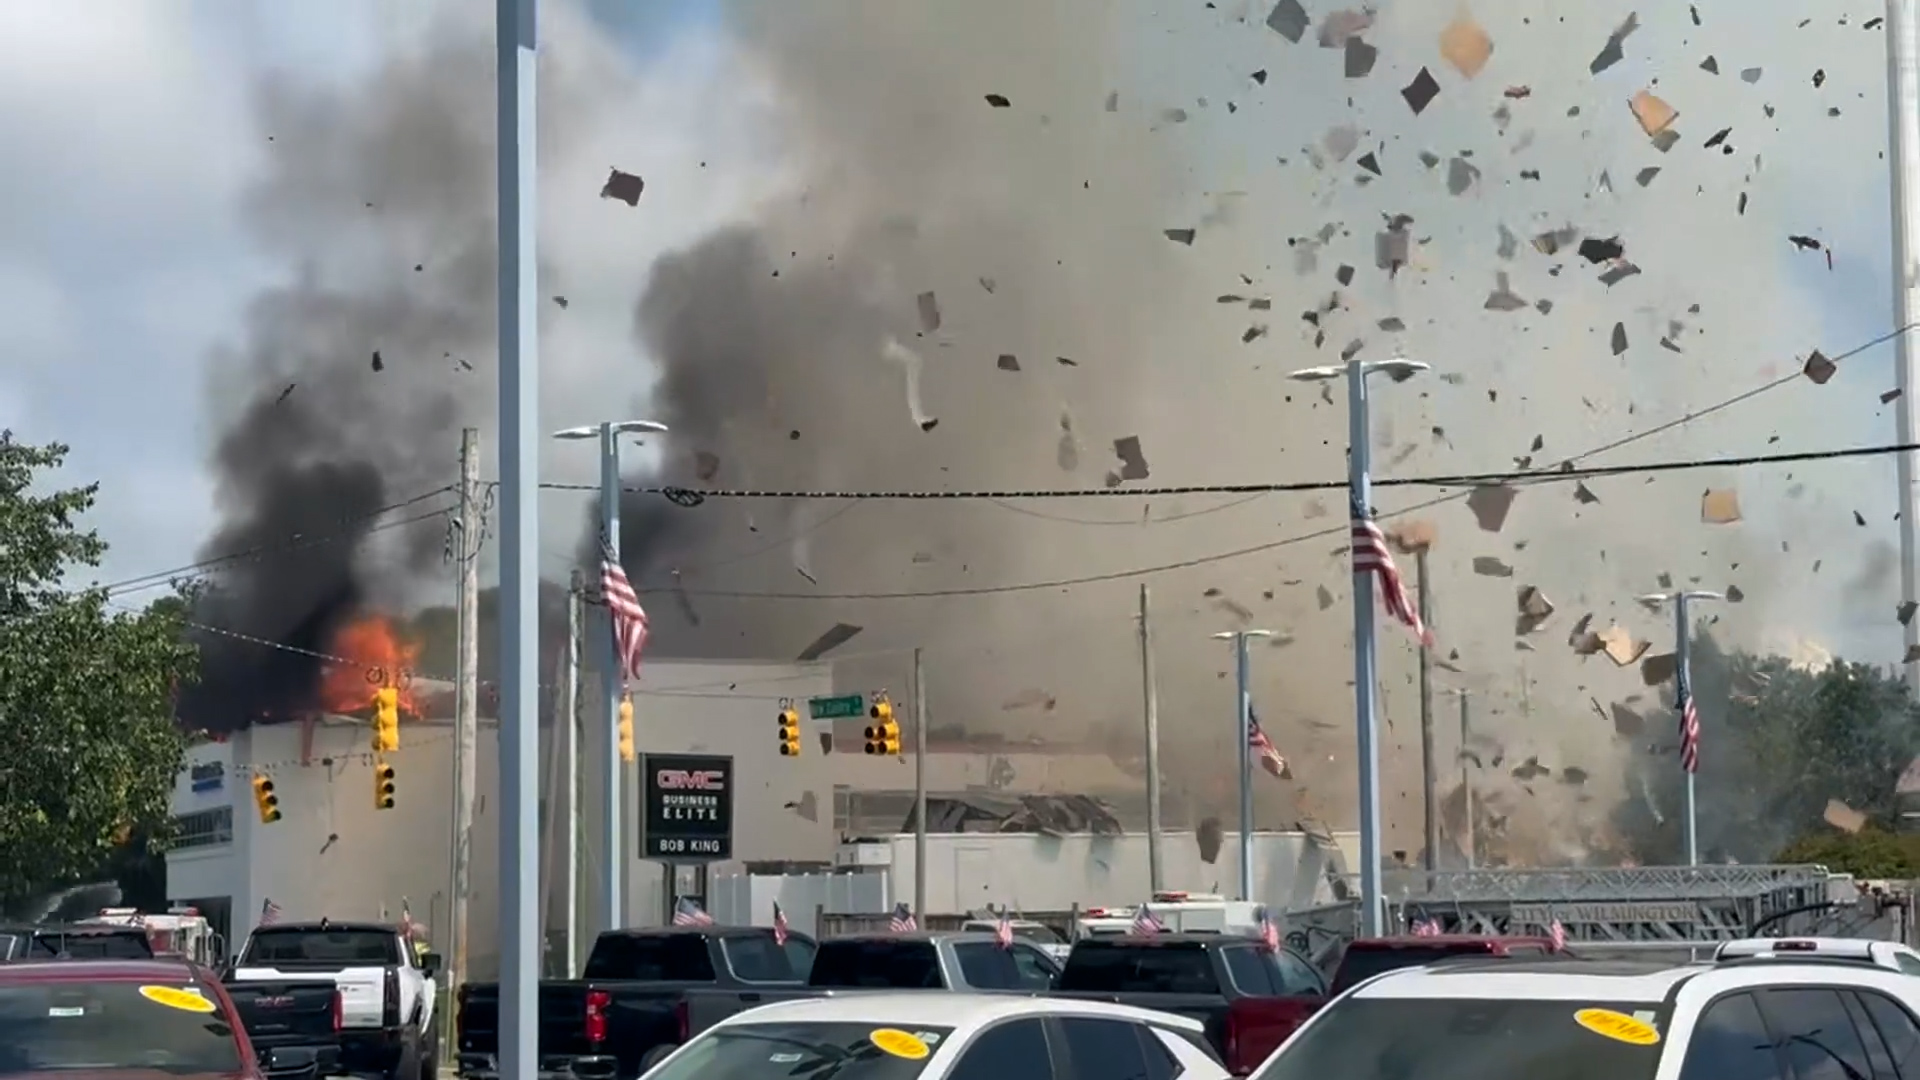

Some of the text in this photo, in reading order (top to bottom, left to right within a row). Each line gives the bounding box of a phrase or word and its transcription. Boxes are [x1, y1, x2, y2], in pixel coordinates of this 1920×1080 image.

[657, 770, 724, 789] GMC
[662, 794, 718, 806] BUSINESS
[662, 807, 718, 820] ELITE
[660, 838, 721, 853] BOB KING
[1510, 906, 1549, 921] CITY
[1575, 903, 1695, 921] WILMINGTON
